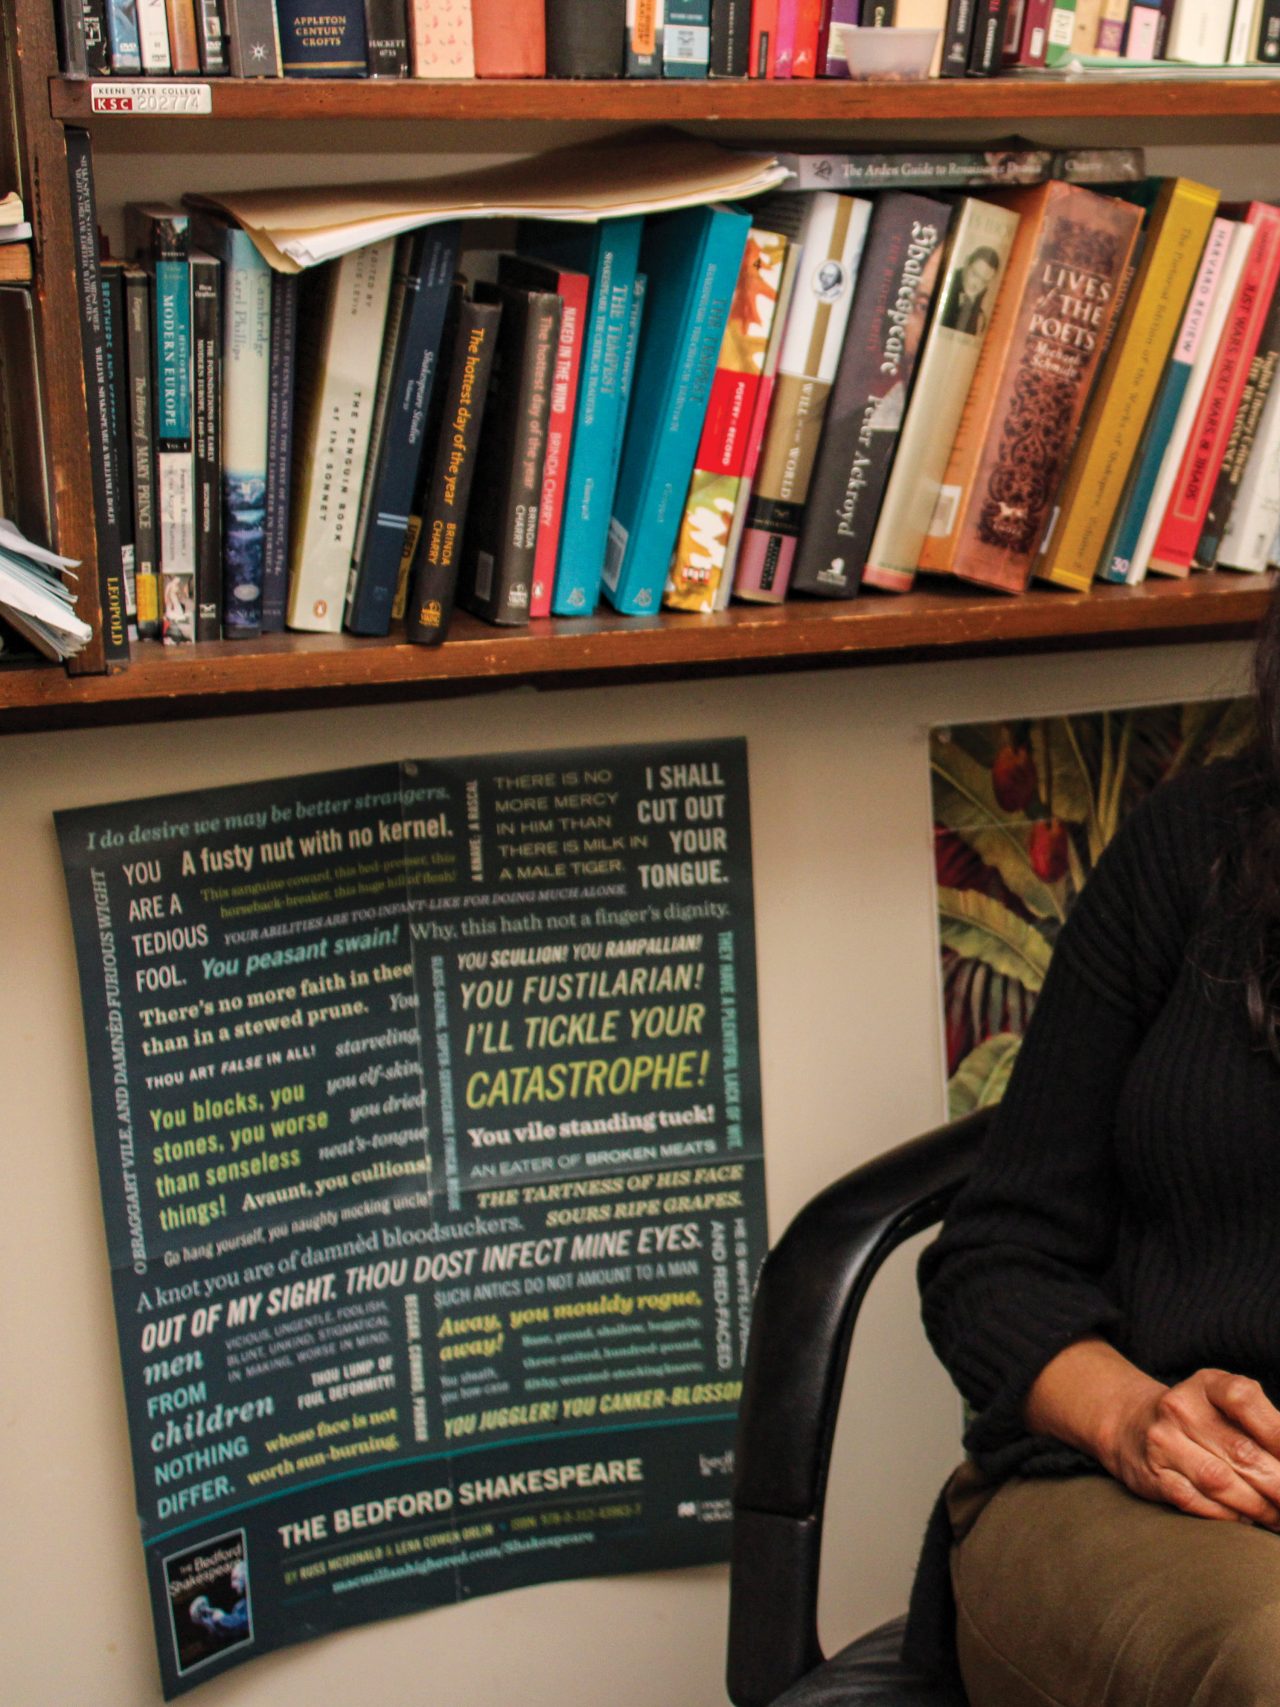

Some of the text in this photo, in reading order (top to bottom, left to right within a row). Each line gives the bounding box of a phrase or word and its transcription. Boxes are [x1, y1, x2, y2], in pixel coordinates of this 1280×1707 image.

[294, 15, 346, 26] APPLETON
[296, 25, 345, 36] CENTURY
[302, 36, 341, 47] CROFTS
[368, 39, 406, 49] HACKETT
[96, 95, 200, 111] KSC 202774
[98, 87, 201, 96] KEENE STATE COLLEGE
[232, 267, 247, 307] Caryl
[880, 220, 938, 376] Shakespeare
[1043, 263, 1113, 301] LIVES
[1184, 229, 1225, 352] HARVARD REVIEW
[1242, 282, 1256, 312] JUST
[162, 294, 176, 362] MODERN
[1059, 293, 1104, 325] THE
[232, 310, 247, 360] Phillips
[601, 284, 628, 398] THE TEMPEST
[1029, 313, 1097, 351] POETS
[196, 339, 206, 376] MODERN
[552, 307, 578, 413] NAKED IN THE WIND
[1218, 358, 1234, 395] HOLY
[163, 367, 178, 427] EUROPE
[206, 340, 215, 463] THE FOUNDATIONS OF EARLY
[408, 349, 436, 445] Shakespeare Studies
[443, 328, 485, 505] The hottest day of the year
[522, 316, 553, 490] The hottest day of the year
[797, 382, 814, 416] WILL
[722, 382, 746, 467] POETRY RECORD
[133, 376, 152, 530] The History of MARY PRINCE
[318, 407, 340, 523] of the SONNET
[334, 391, 363, 543] THE PENGUIN BOOK
[545, 432, 563, 476] BRINDA
[780, 446, 801, 500] WORLD
[836, 395, 881, 537] Peter Ackroyd
[1186, 458, 1206, 499] JIHADS
[541, 478, 558, 526] CHARRY
[428, 520, 445, 565] CHARRY
[440, 522, 456, 566] BRINDA
[511, 504, 526, 548] CHARRY
[524, 505, 538, 549] BRINDA
[1111, 556, 1130, 573] 30
[105, 576, 124, 646] LEOPOLD
[645, 762, 725, 791] I SHALL
[86, 785, 451, 851] I do desire we may be better strangers.
[637, 794, 725, 825] CUT OUT
[182, 813, 455, 877] A fusty nut with no kernel.
[669, 828, 728, 855] YOUR
[122, 861, 162, 887] YOU
[638, 860, 730, 890] TONGUE.
[128, 893, 182, 922] ARE A
[132, 924, 209, 958] TEDIOUS
[201, 924, 399, 980] You peasant swain!
[135, 965, 187, 993] FOOL.
[461, 963, 706, 1012] YOU FUSTILARIAN!
[464, 1003, 706, 1057] I'LL TICKLE YOUR
[465, 1049, 711, 1111] CATASTROPHE!
[150, 1082, 306, 1132] You blocks, you
[467, 1104, 715, 1149] You vile standing tuck!
[153, 1109, 329, 1167] stones, you worse
[155, 1148, 301, 1200] than senseless
[159, 1196, 227, 1233] things!
[140, 1222, 703, 1353] OUT OF MY SIGHT. THOU DOST INFECT MINE EYES.
[143, 1350, 205, 1386] men
[147, 1381, 207, 1419] FROM
[150, 1396, 275, 1454] children
[154, 1436, 249, 1487] NOTHING
[157, 1474, 236, 1520] DIFFER.
[279, 1516, 329, 1550] THE
[334, 1485, 454, 1534] BEDFORD
[459, 1457, 644, 1507] SHAKESPEARE
